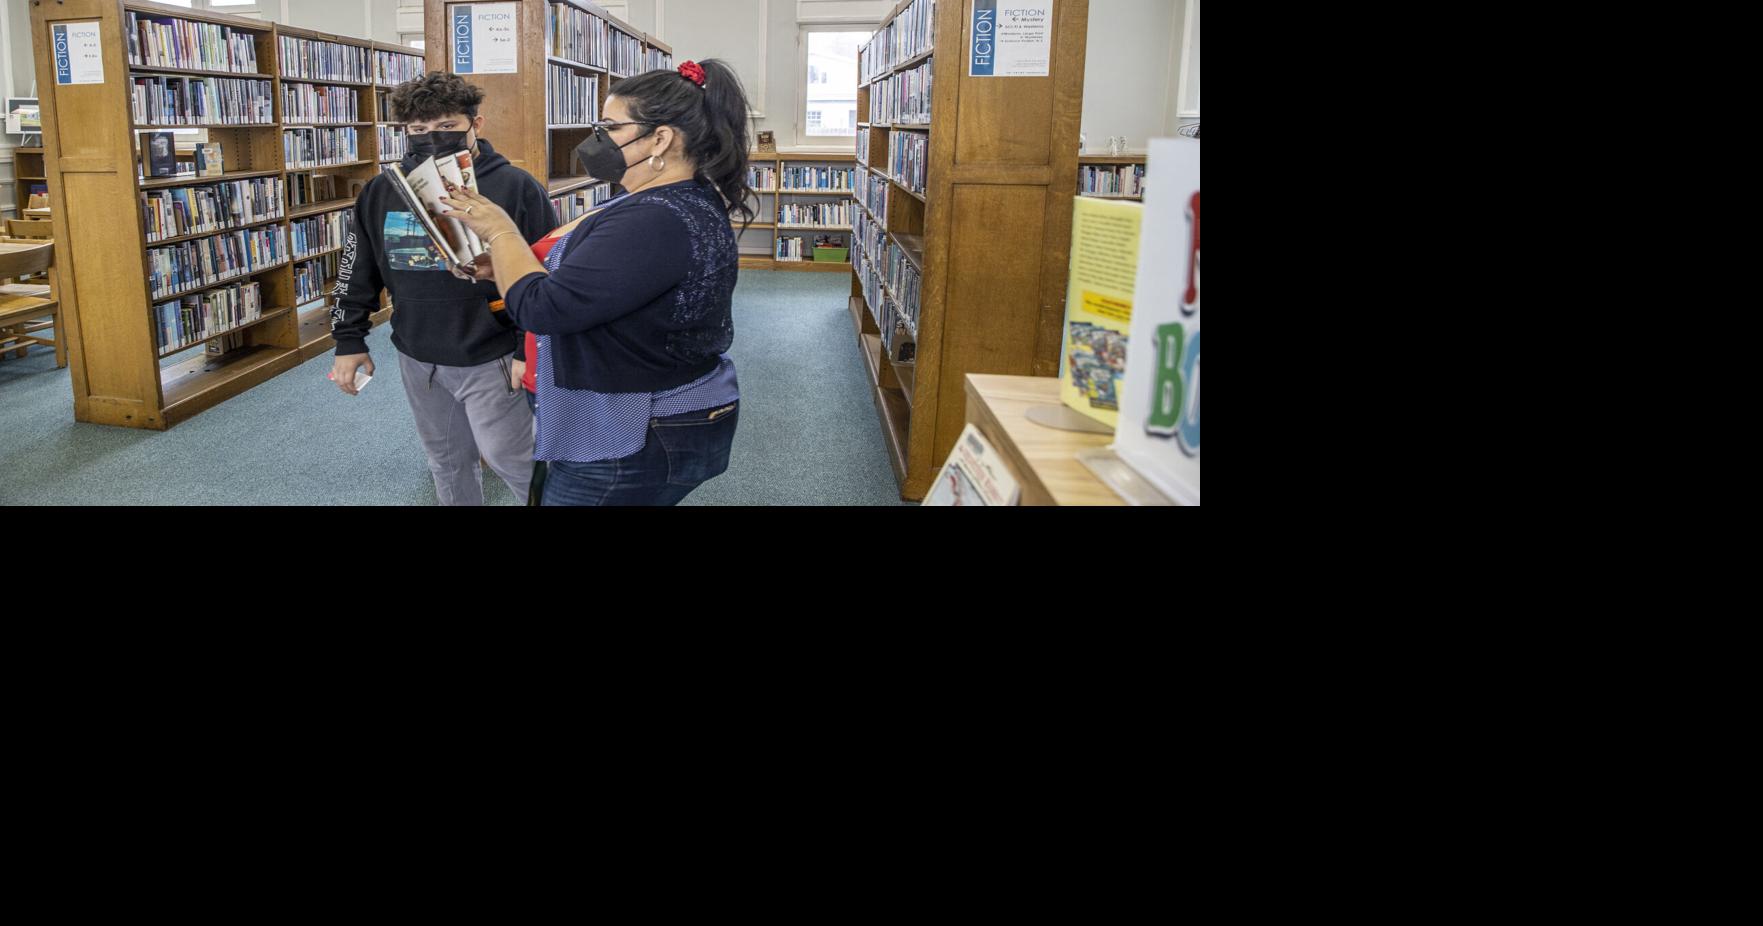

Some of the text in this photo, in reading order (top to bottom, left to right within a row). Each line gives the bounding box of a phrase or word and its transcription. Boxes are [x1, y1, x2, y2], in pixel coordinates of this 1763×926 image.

[56, 32, 70, 76] FICTION
[456, 15, 470, 64] FICTION
[975, 9, 992, 65] FICTION
